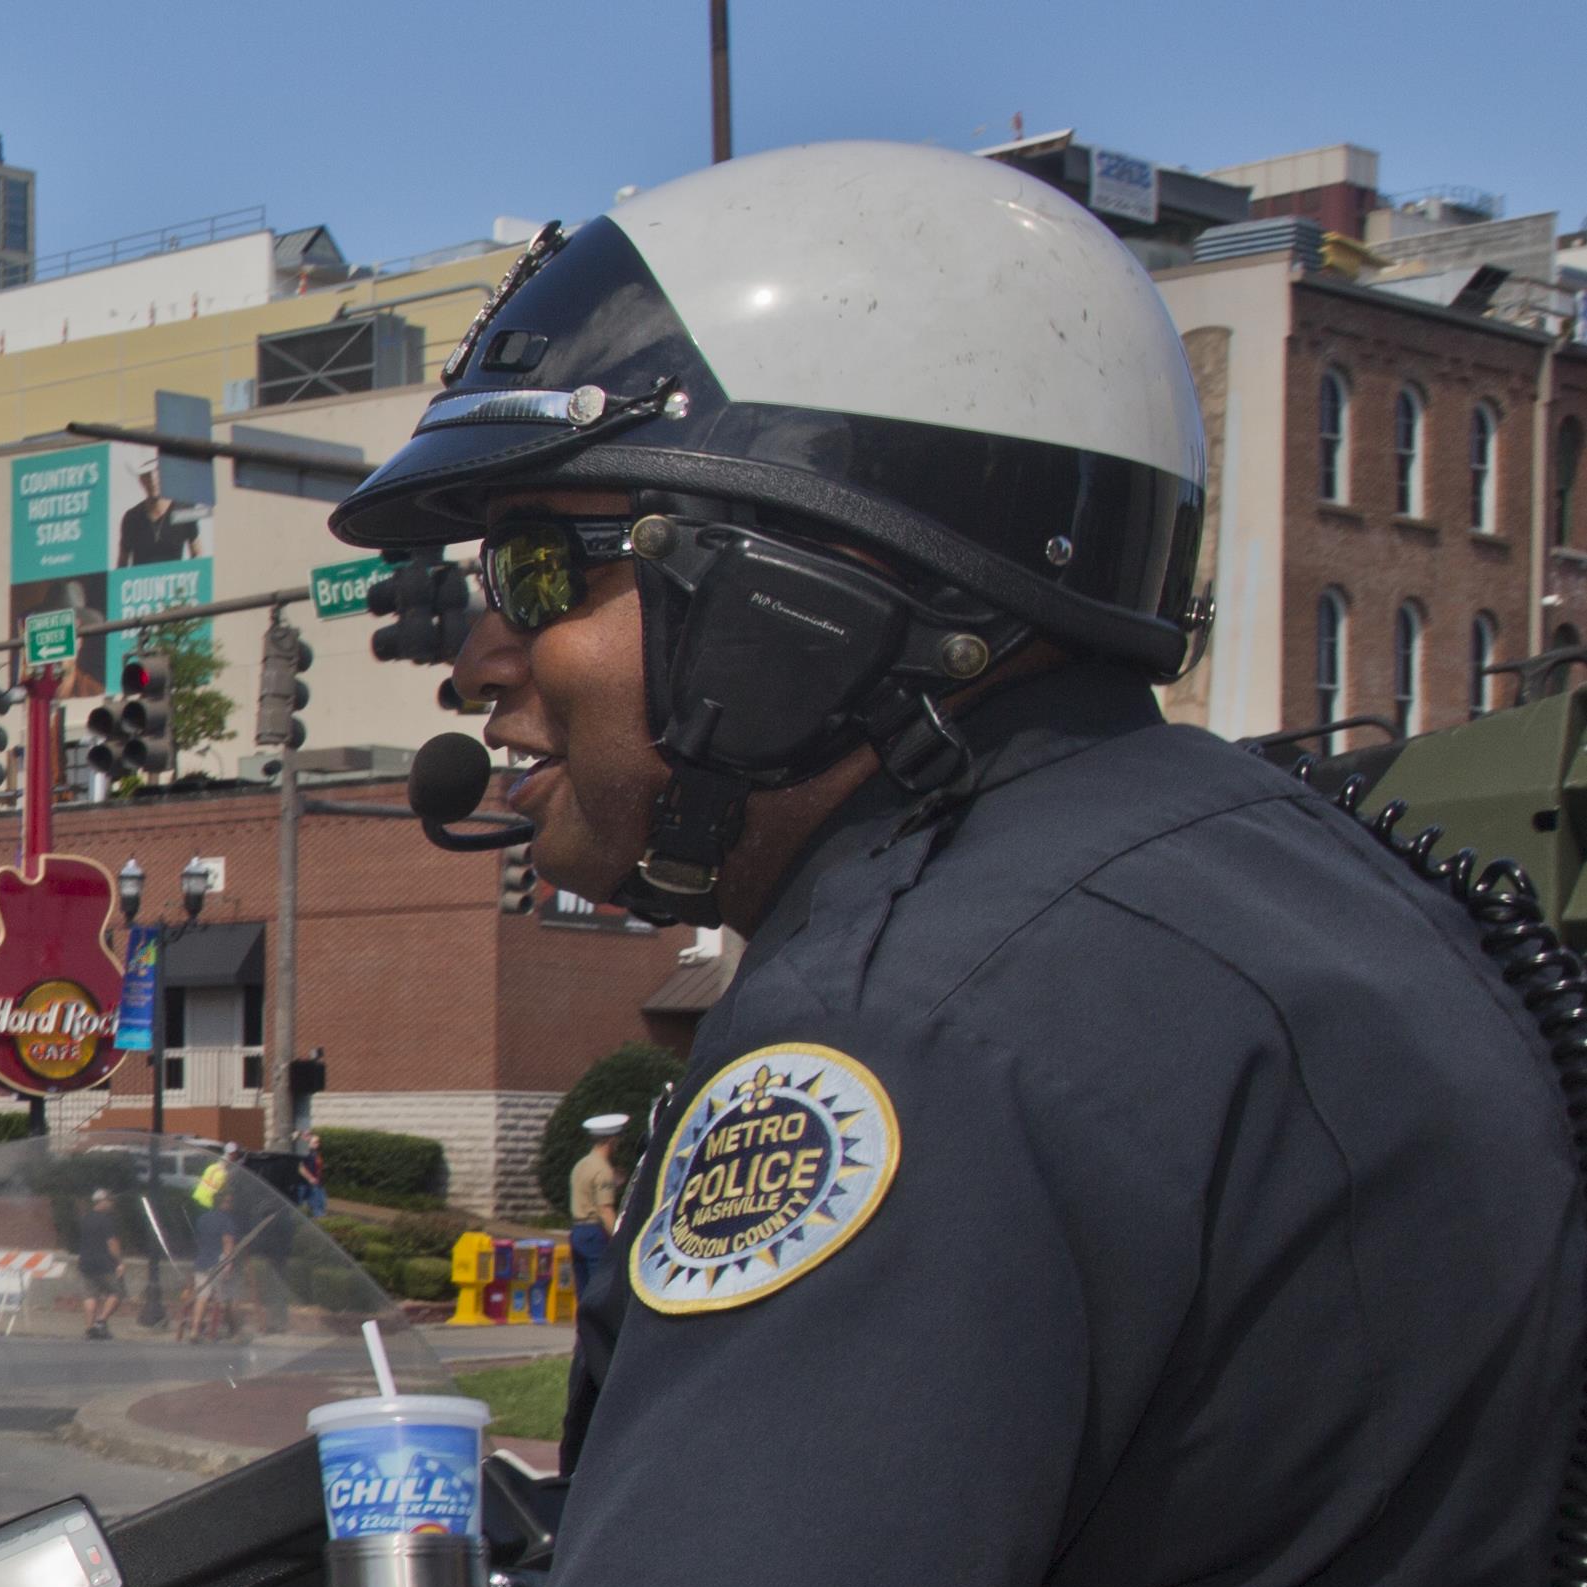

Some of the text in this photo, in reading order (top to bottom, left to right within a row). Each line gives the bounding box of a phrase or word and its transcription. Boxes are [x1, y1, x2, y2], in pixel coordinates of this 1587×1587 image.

[20, 462, 99, 496] COUNTRY'S
[28, 491, 91, 521] HOTTEST
[36, 520, 81, 546] STARS
[122, 571, 200, 605] COUNTRY
[704, 1111, 807, 1162] METRO
[677, 1148, 823, 1216] POLICE
[671, 1190, 811, 1259] DAVIDSON COUNTY
[692, 1192, 781, 1228] NASHVILLE
[330, 1476, 453, 1509] CHILL
[395, 1503, 473, 1517] EXPRESS
